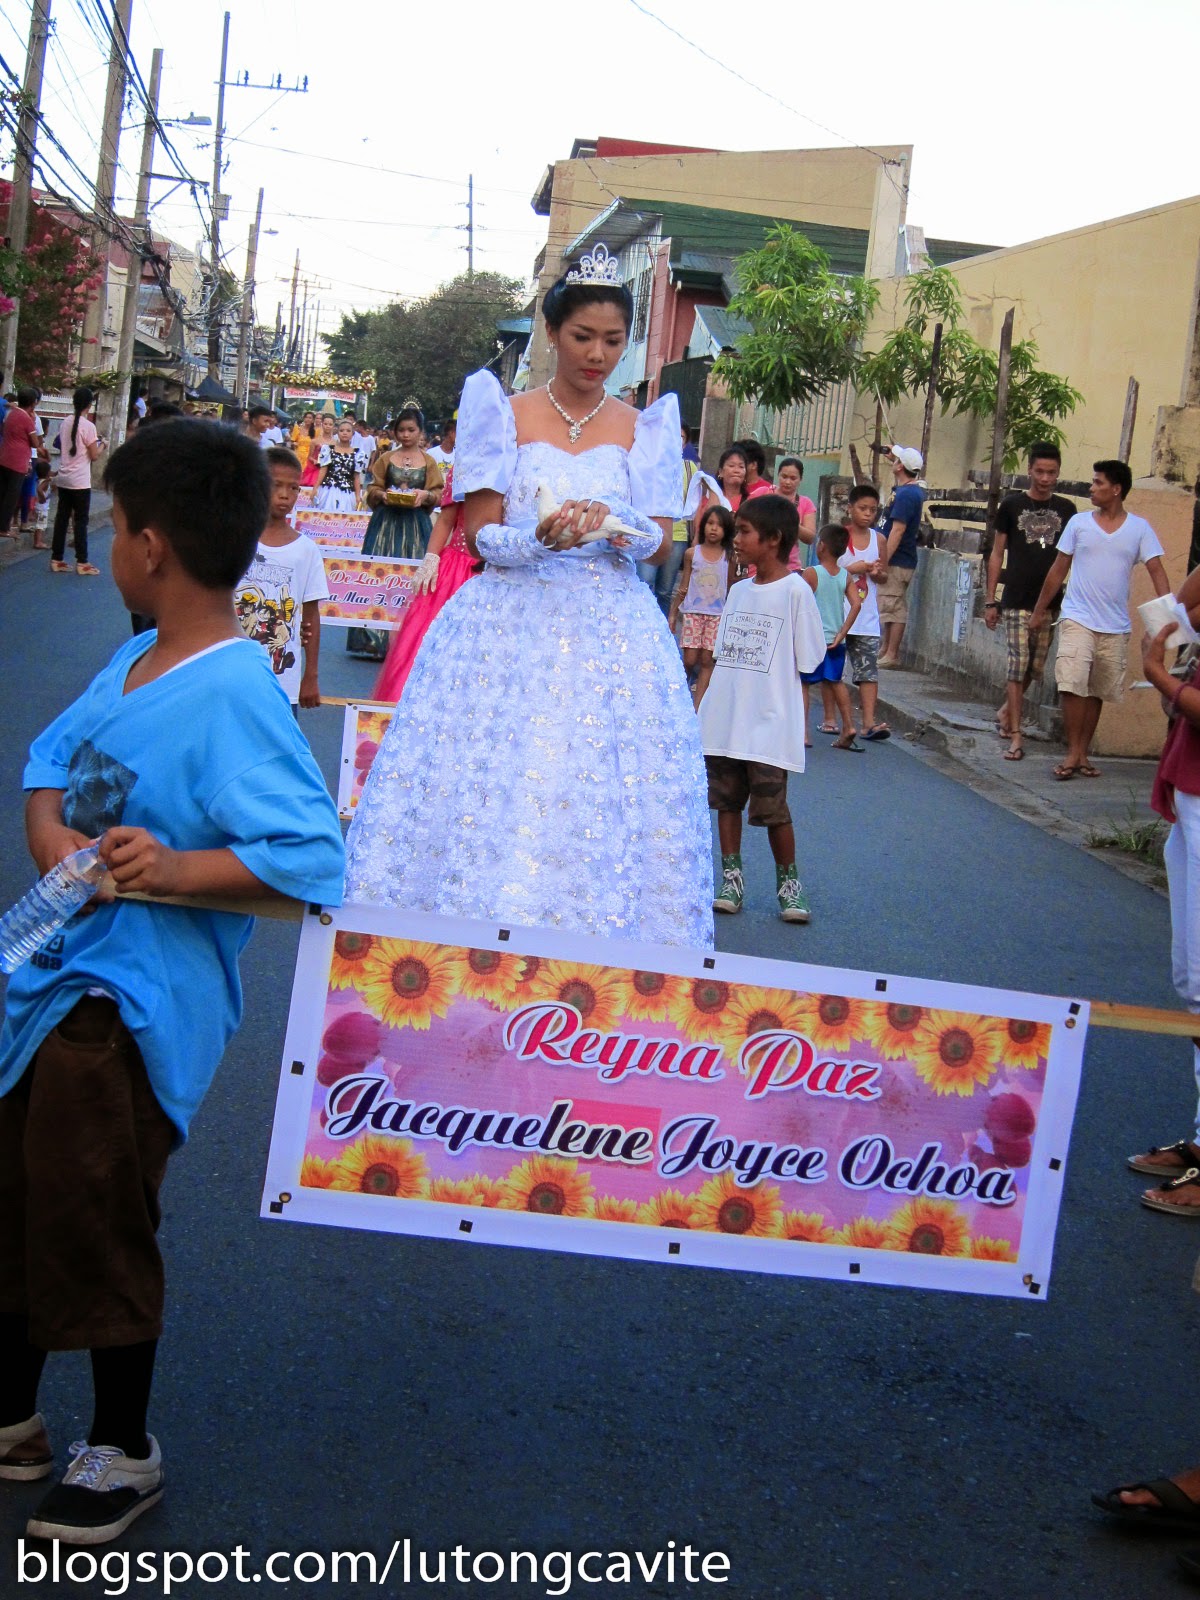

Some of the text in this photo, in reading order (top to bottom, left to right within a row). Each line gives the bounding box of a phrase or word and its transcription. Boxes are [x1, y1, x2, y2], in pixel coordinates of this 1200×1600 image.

[330, 570, 412, 590] De Las Pro
[342, 591, 370, 605] Mae
[505, 1002, 881, 1099] Reyna Paz
[327, 1074, 1016, 1204] Jacquelene Joyce Ochoa
